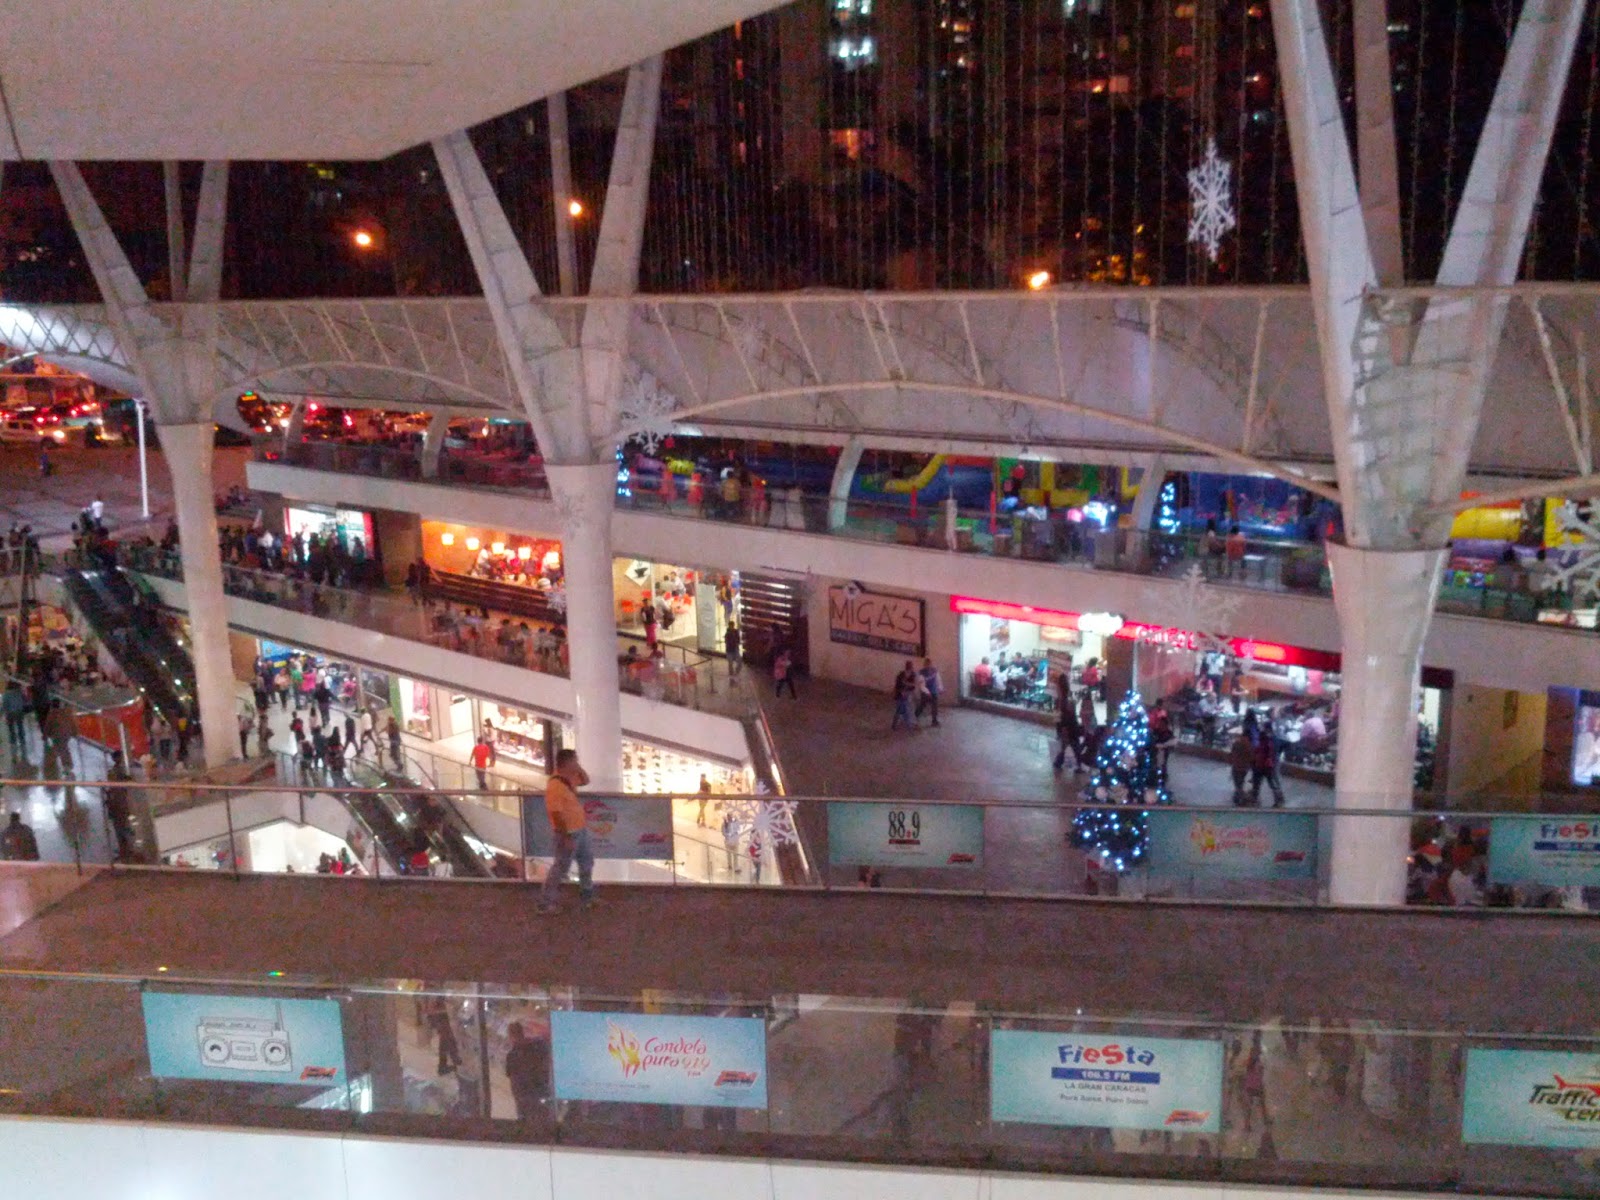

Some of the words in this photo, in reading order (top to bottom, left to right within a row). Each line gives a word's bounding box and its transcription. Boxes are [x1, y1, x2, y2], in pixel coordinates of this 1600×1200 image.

[831, 599, 917, 634] MIGA'S
[888, 811, 920, 839] 88.9
[644, 1036, 707, 1055] Candela
[1114, 1072, 1131, 1081] FM
